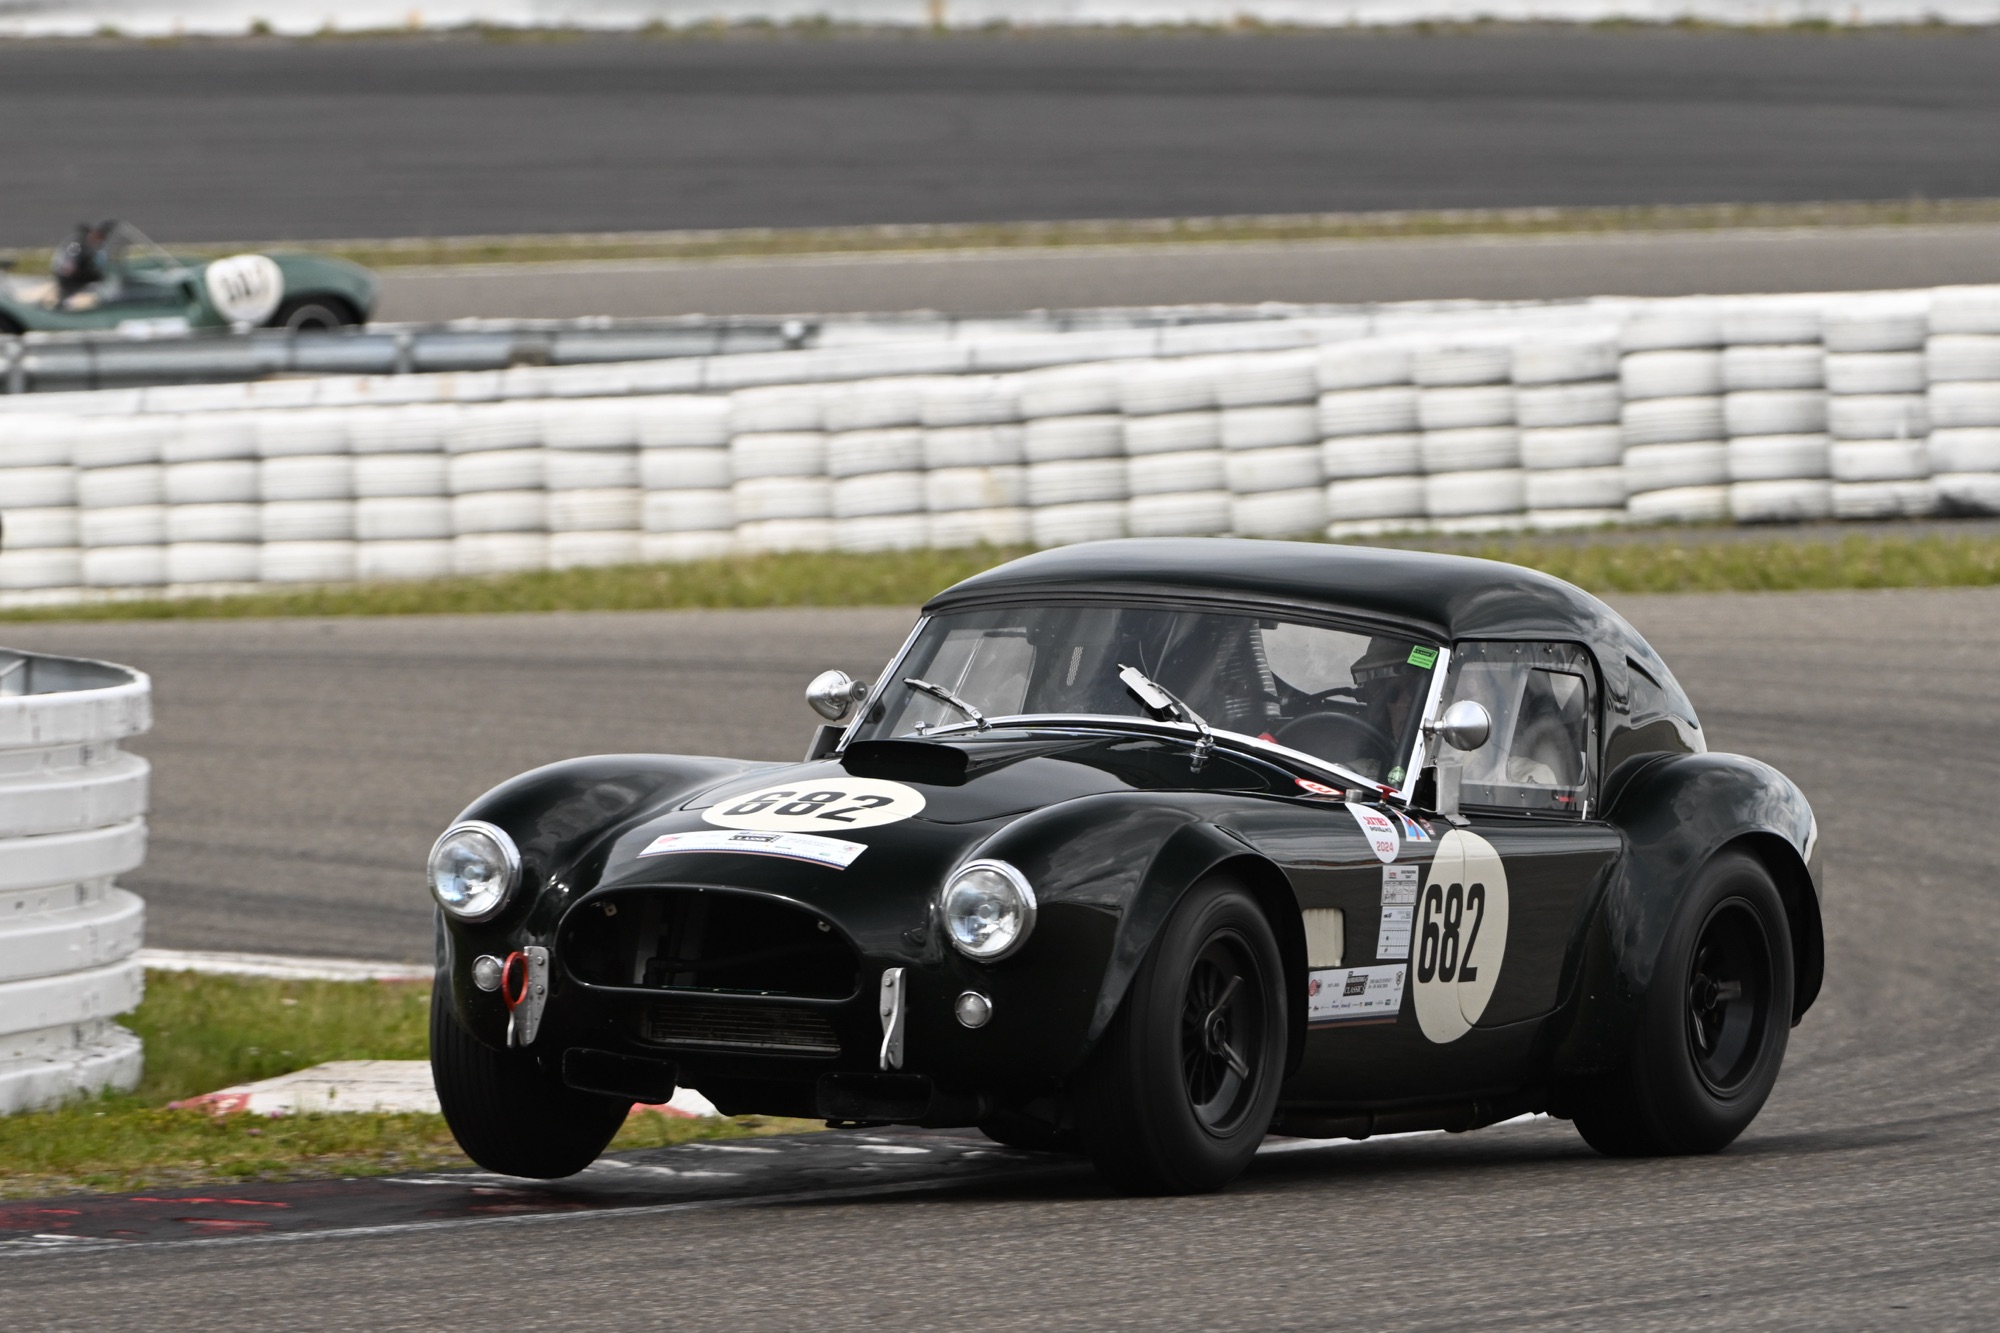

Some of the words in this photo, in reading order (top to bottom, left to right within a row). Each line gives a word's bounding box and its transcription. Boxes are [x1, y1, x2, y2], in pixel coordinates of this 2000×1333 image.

[723, 791, 895, 823] 682
[1376, 841, 1394, 852] 2024
[1417, 883, 1485, 983] 682
